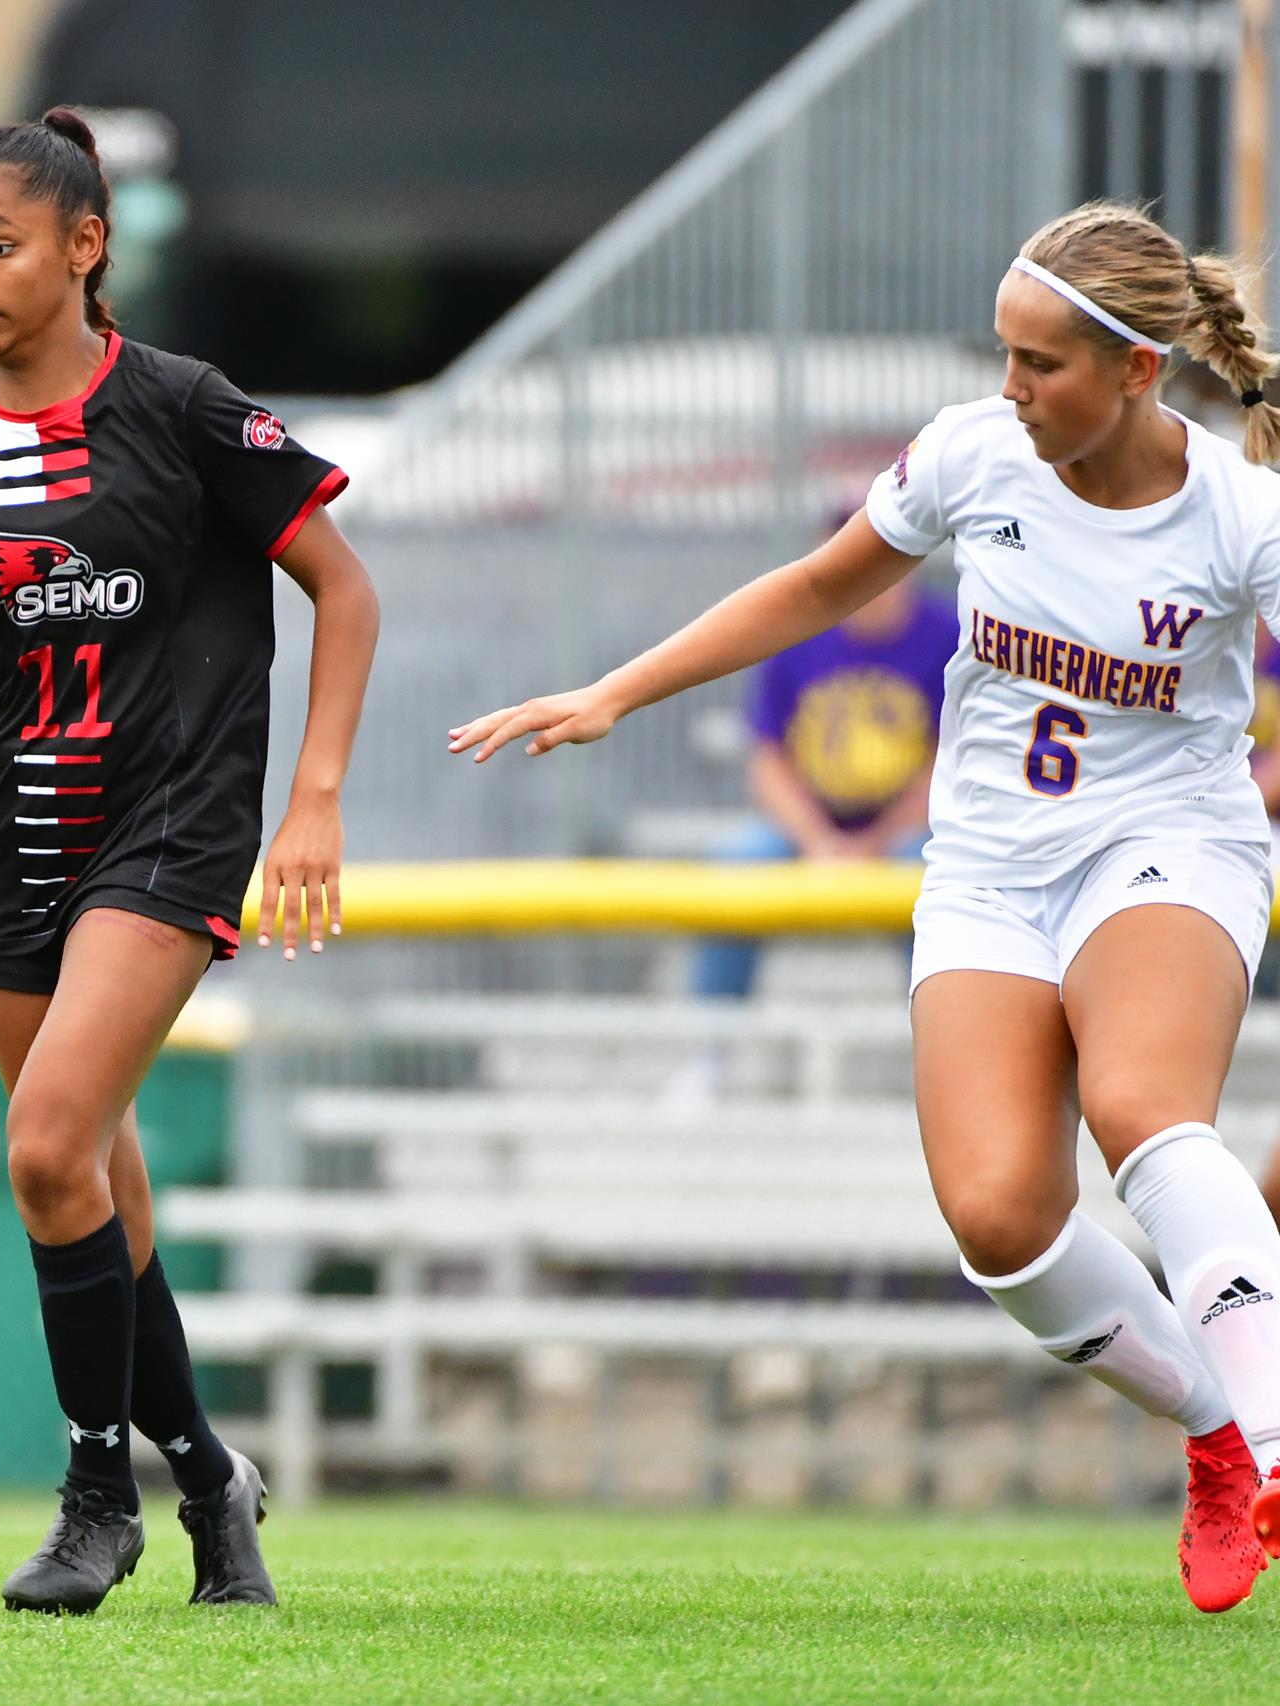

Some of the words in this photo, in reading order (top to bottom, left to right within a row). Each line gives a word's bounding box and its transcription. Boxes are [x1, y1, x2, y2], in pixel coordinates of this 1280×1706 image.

[990, 535, 1026, 551] adidas
[14, 574, 138, 621] SEMO
[1138, 598, 1204, 650] W
[971, 606, 1182, 715] LEATHERNECKS
[17, 642, 114, 741] 11
[1023, 699, 1089, 800] 6
[1126, 876, 1169, 889] adidas
[1200, 1291, 1274, 1325] adidas
